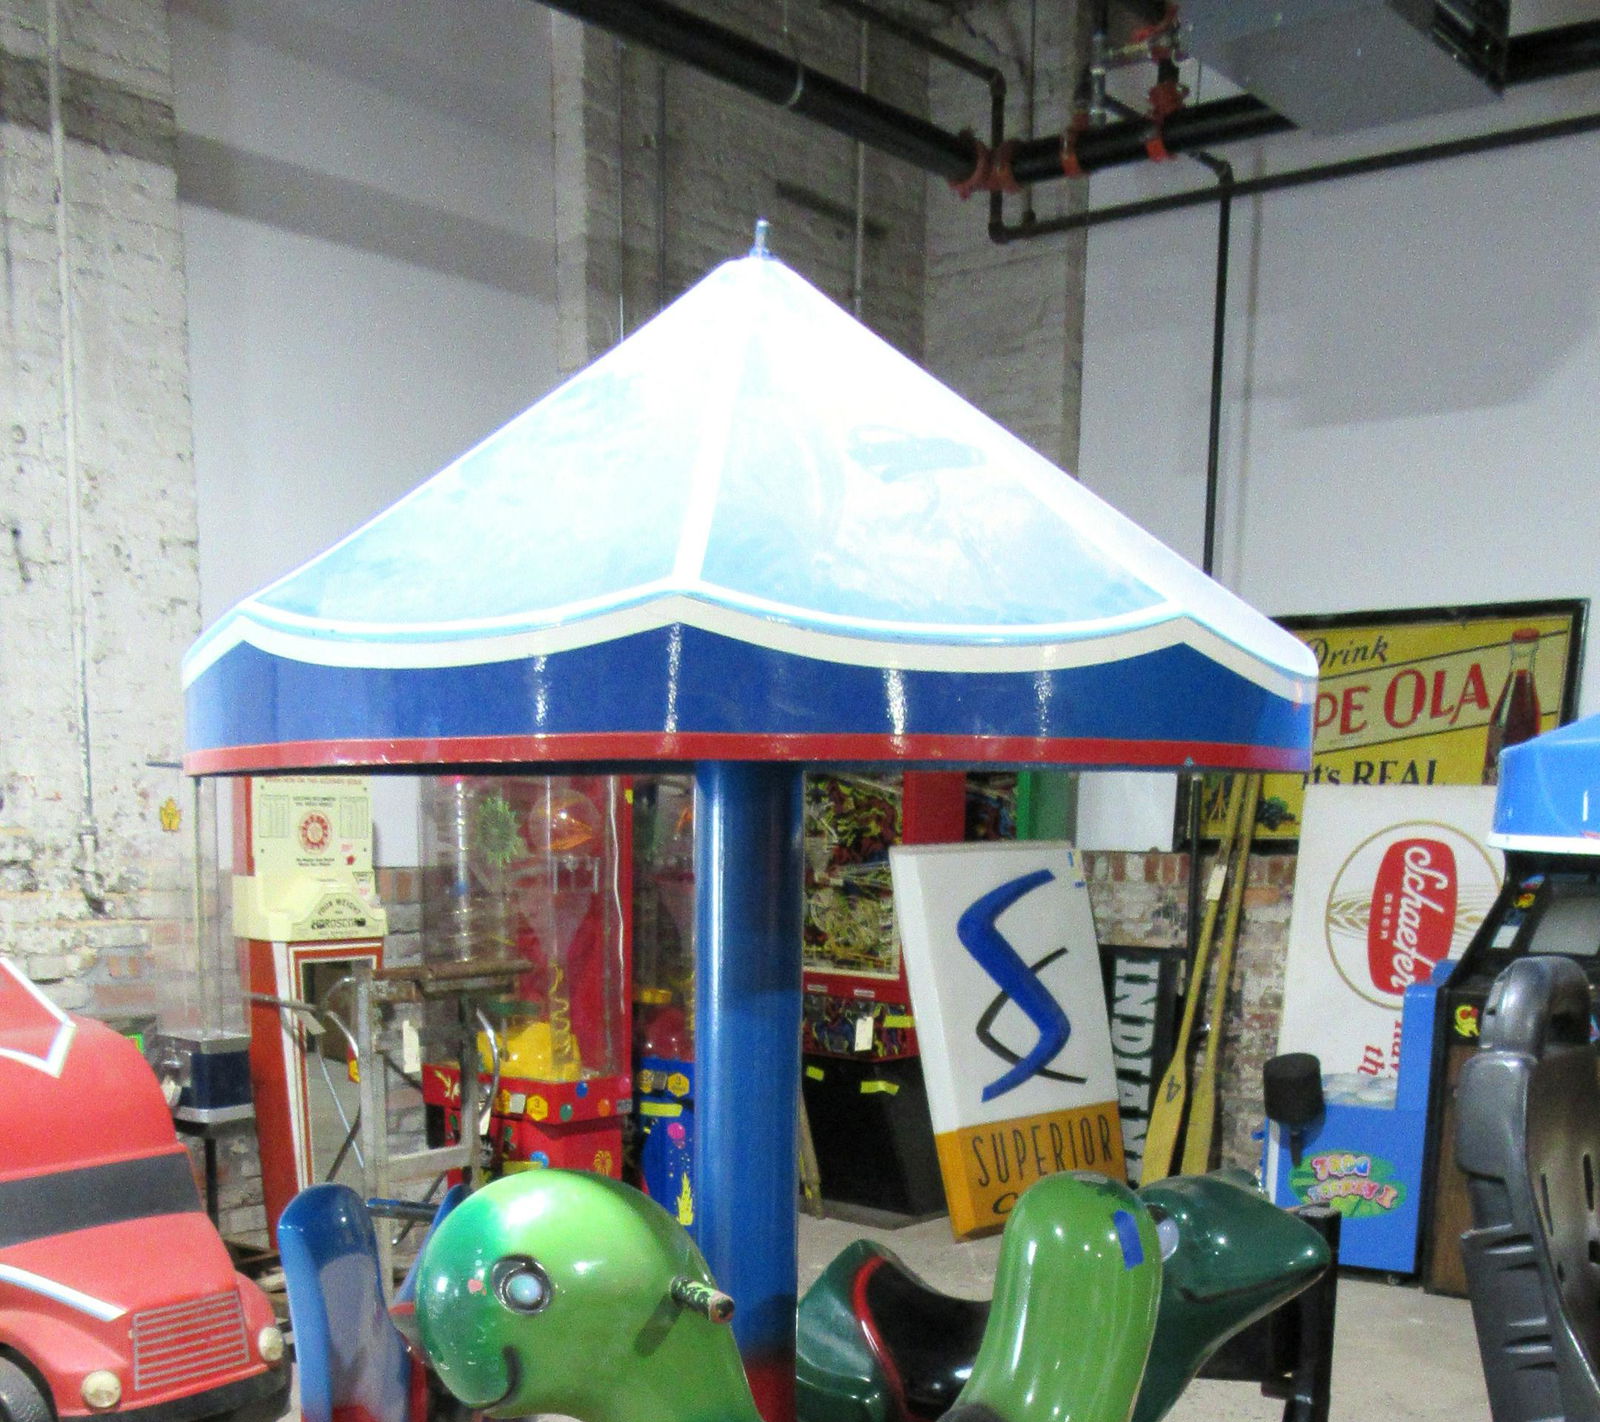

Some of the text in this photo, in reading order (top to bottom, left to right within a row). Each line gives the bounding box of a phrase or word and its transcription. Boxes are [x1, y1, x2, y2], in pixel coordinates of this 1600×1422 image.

[1309, 634, 1389, 669] Drink
[1383, 662, 1490, 730] OLA
[1380, 892, 1394, 940] BEER
[1390, 846, 1449, 989] Schaefer
[972, 1113, 1113, 1188] SUPERIOR
